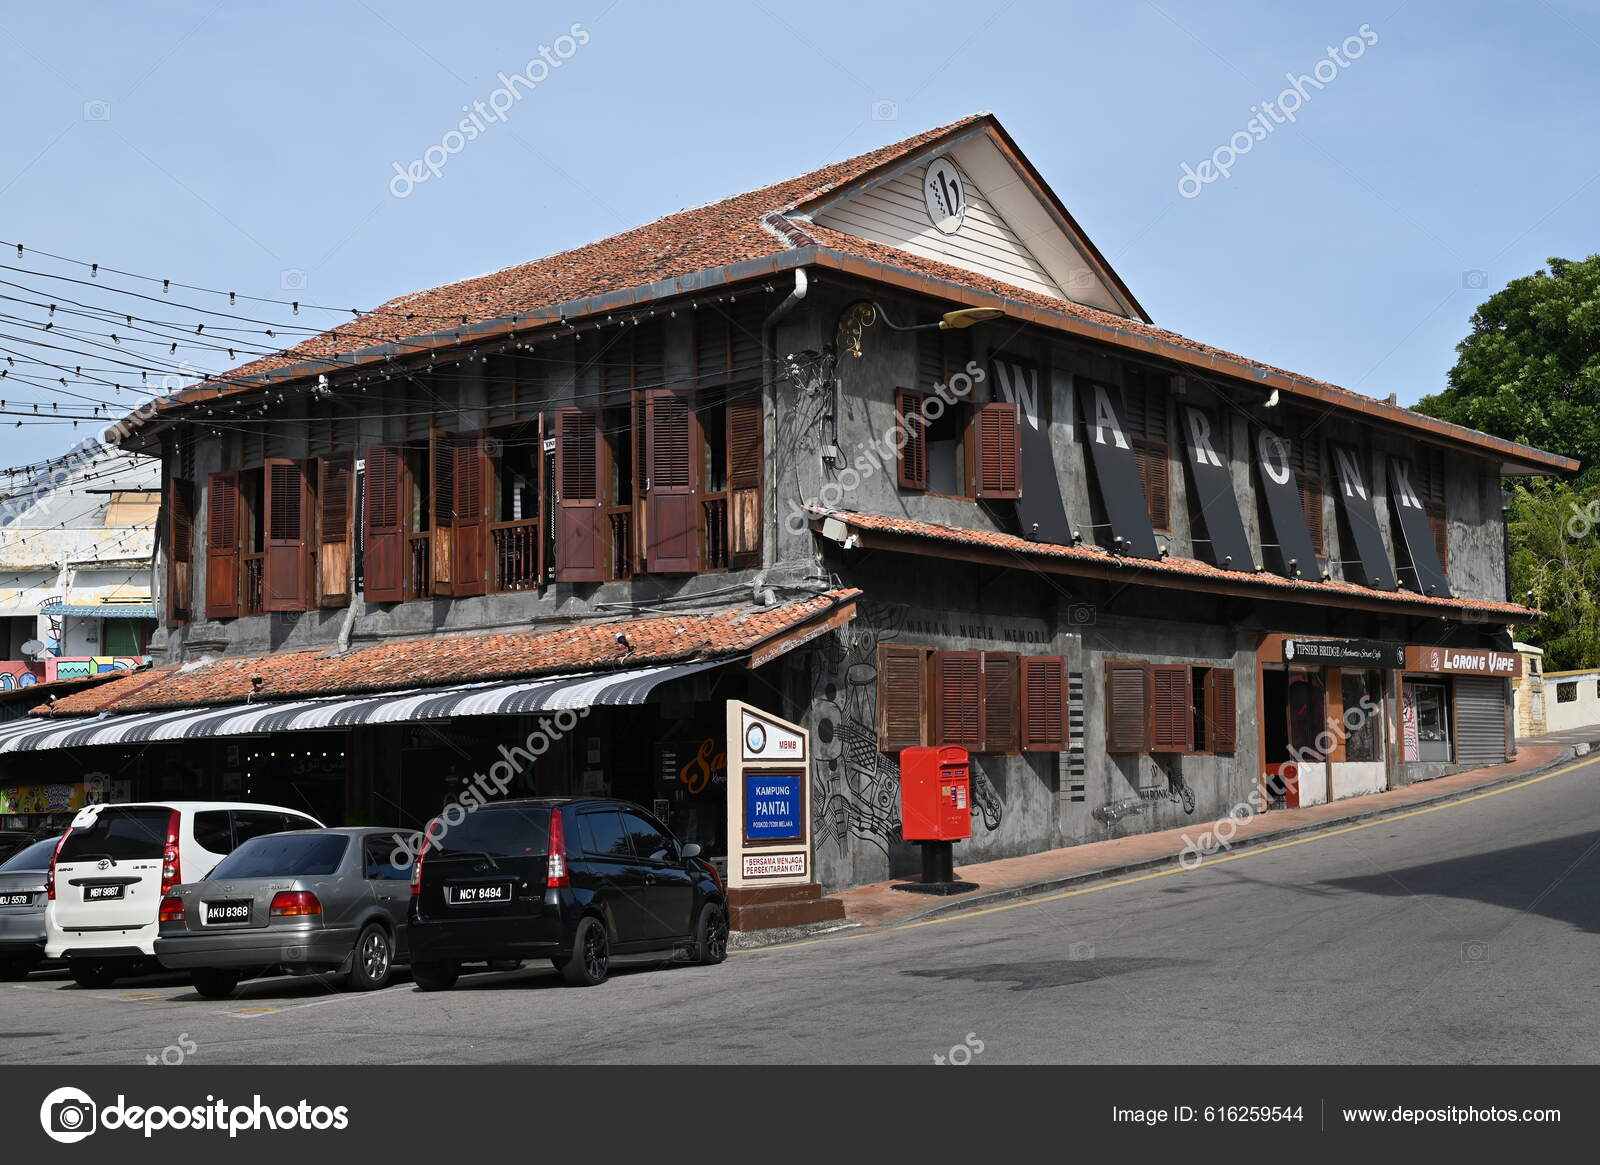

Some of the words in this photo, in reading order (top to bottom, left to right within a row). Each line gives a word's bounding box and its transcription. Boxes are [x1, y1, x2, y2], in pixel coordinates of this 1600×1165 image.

[1320, 646, 1340, 657] BRIDGE
[1443, 649, 1485, 671] LORONG
[1488, 652, 1514, 673] VAPE
[779, 740, 797, 750] MBMB
[755, 786, 790, 795] KAMPUNG
[755, 801, 790, 816] PANTAI
[777, 856, 803, 865] MENJAGA
[746, 865, 789, 874] PERSEKITARAN
[102, 886, 119, 896] 9887
[459, 889, 476, 900] NCY
[479, 887, 501, 898] 8494
[11, 895, 27, 904] 5578
[208, 908, 225, 918] AKU
[226, 906, 248, 917] 8368
